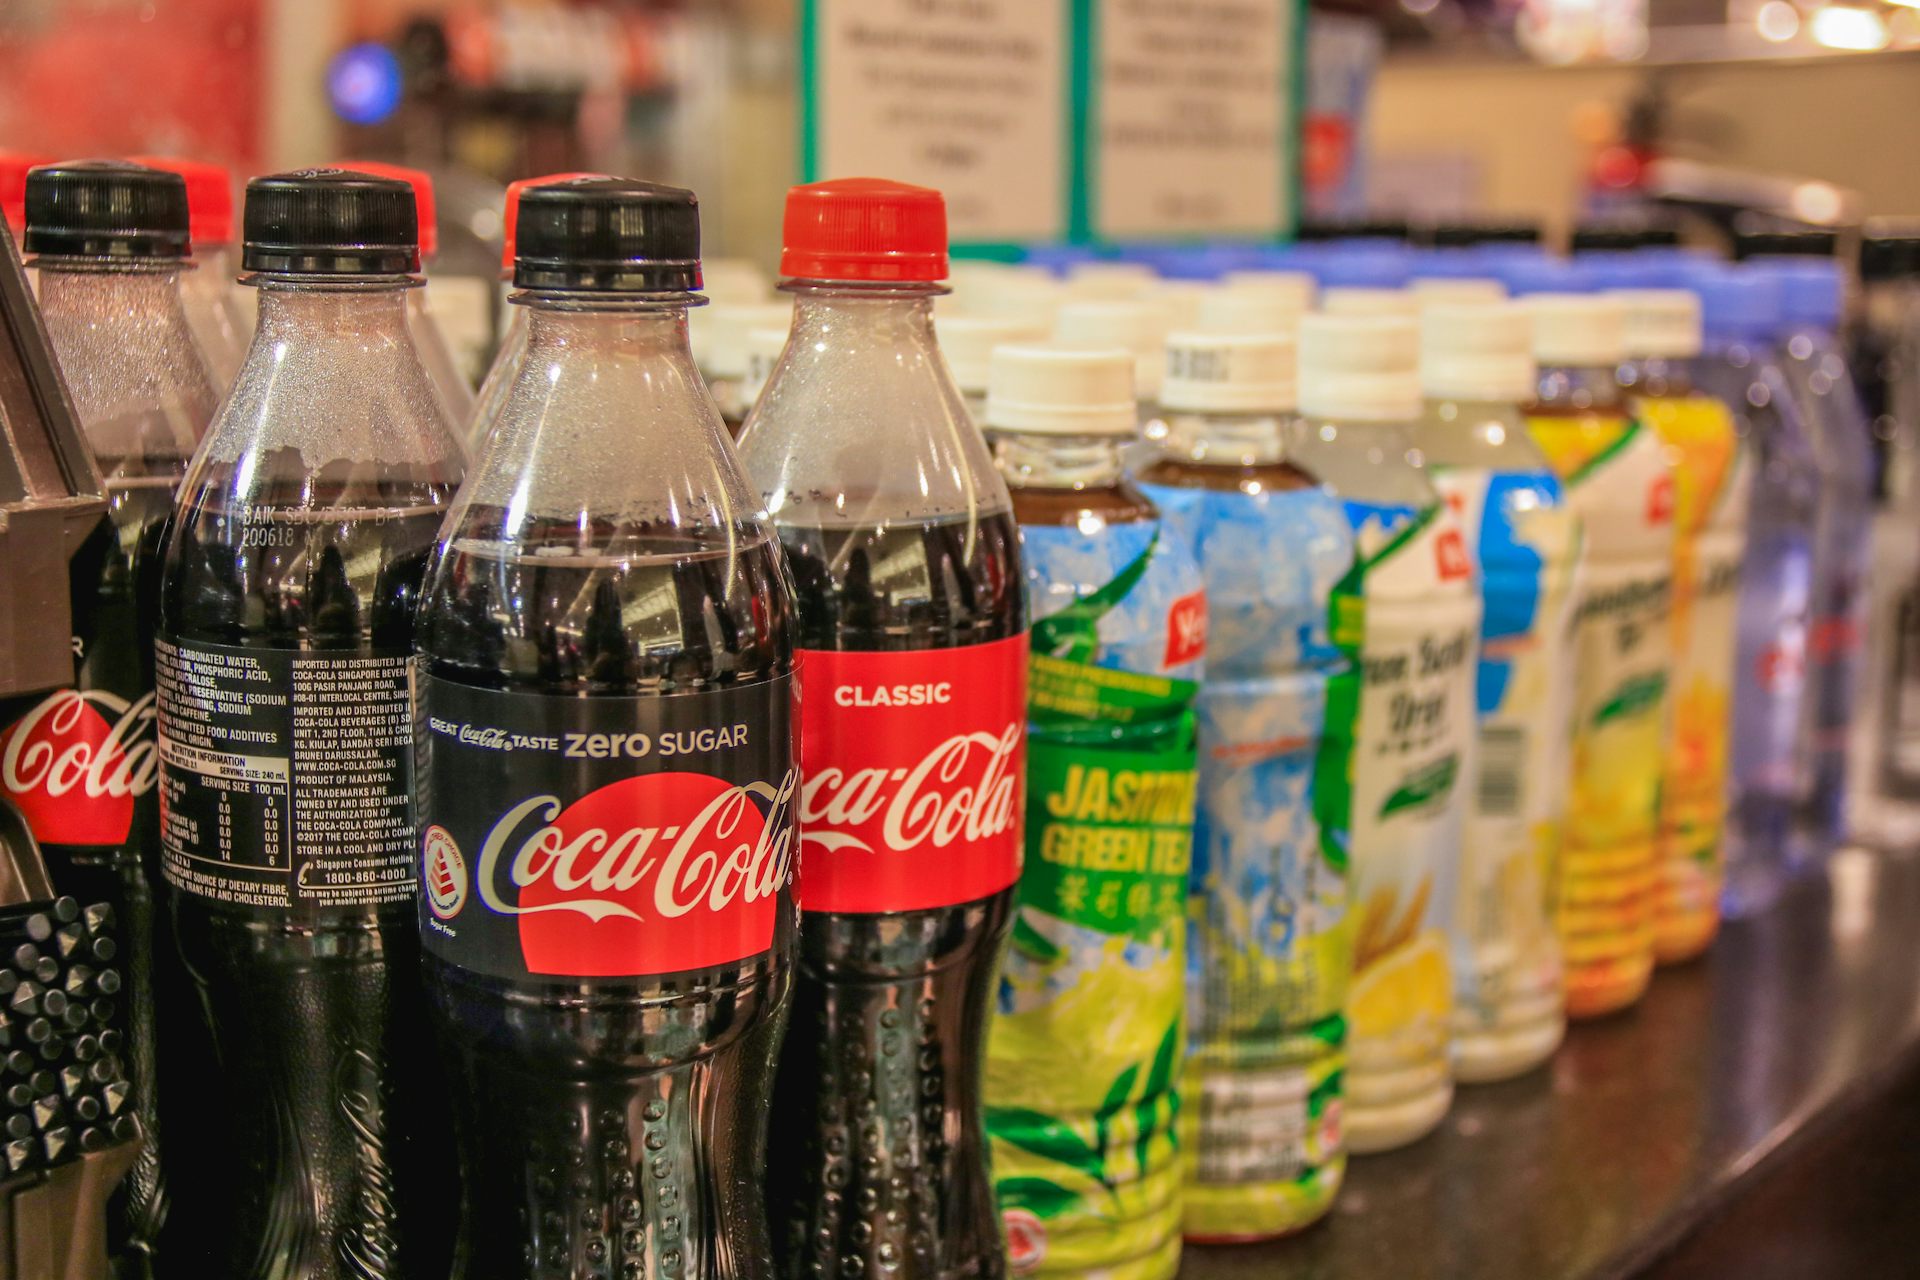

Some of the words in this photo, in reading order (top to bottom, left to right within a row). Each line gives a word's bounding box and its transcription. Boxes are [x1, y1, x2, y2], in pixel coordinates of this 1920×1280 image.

[243, 506, 276, 526] BAIK
[242, 527, 294, 547] 200618
[179, 648, 224, 666] CARBONATED
[226, 656, 261, 670] WATER,
[292, 660, 330, 669] IMPORTED
[331, 660, 347, 669] AND
[349, 658, 395, 668] DISTRIBUTED
[397, 657, 404, 666] IN
[176, 671, 218, 689] (SUCRALOSE,
[194, 663, 244, 679] PHOSPHORIC
[245, 670, 271, 683] ACID,
[293, 671, 336, 681] COCA-COLA
[338, 670, 380, 679] SINGAPORE
[314, 682, 336, 692] PASIR
[338, 681, 372, 691] PANJANG
[834, 682, 951, 706] CLASSIC
[189, 684, 243, 703] PRESERVATIVE
[245, 694, 287, 706] (SODIUM
[293, 693, 317, 703] #08-01
[319, 692, 362, 702] INTERLOCAL
[363, 691, 392, 701] CENTRE,
[175, 693, 217, 713] FLAVOURING,
[218, 702, 251, 716] SODIUM
[293, 706, 333, 716] IMPORTED
[336, 706, 352, 716] AND
[354, 704, 403, 715] DISTRIBUTED
[180, 707, 212, 722] CAFFEINE.
[294, 718, 339, 727] COCA-COLA
[341, 716, 386, 727] BEVERAGES
[388, 716, 399, 725] (B)
[172, 718, 205, 735] PERMITTED
[206, 727, 227, 739] FOOD
[229, 730, 278, 743] ADDITIVES
[294, 729, 312, 738] UNIT
[313, 729, 320, 739] 1,
[322, 729, 338, 738] 2ND
[340, 728, 367, 738] FLOOR,
[369, 727, 387, 736] TIAN
[388, 727, 394, 735] &
[430, 717, 458, 736] GREAT
[511, 735, 559, 751] TASTE
[565, 733, 651, 759] zero
[658, 723, 749, 756] SUGAR
[294, 740, 307, 749] KG.
[309, 740, 340, 750] KIULAP,
[341, 739, 373, 749] BANDAR
[375, 738, 393, 748] SERI
[394, 736, 414, 746] BEGA
[171, 743, 196, 758] NUTRITION
[198, 749, 245, 767] INFORMATION
[295, 751, 323, 760] BRUNEI
[325, 749, 381, 760] DARUSSALAM.
[295, 759, 397, 771] WWW.COCA-COLA.COM.SG
[220, 766, 244, 777] SERVING
[245, 769, 260, 778] SIZE:
[262, 771, 274, 780] 240
[276, 772, 286, 780] mL
[295, 775, 334, 785] PRODUCT
[336, 775, 347, 784] OF
[349, 772, 394, 784] MALAYSIA.
[201, 775, 231, 791] SERVING
[232, 781, 250, 793] SIZE
[255, 783, 271, 794] 100
[273, 785, 286, 795] mL
[295, 788, 311, 798] ALL
[313, 787, 369, 798] TRADEMARKS
[371, 786, 388, 796] ARE
[801, 722, 1023, 854] ca-Cola
[221, 791, 227, 801] 0
[267, 796, 273, 806] 0
[296, 799, 325, 809] OWNED
[327, 799, 339, 809] BY
[340, 799, 358, 808] AND
[359, 798, 380, 808] USED
[382, 795, 409, 806] UNDER
[219, 803, 231, 814] 0.0
[264, 808, 278, 819] 0.0
[296, 810, 312, 820] THE
[313, 809, 379, 820] AUTHORIZATION
[380, 808, 391, 817] OF
[219, 815, 231, 826] 0.0
[264, 820, 278, 831] 0.0
[296, 821, 312, 830] THE
[314, 820, 361, 831] COCA-COLA
[363, 817, 404, 829] COMPANY.
[219, 827, 231, 838] 0.0
[264, 832, 278, 842] 0.0
[325, 832, 341, 841] THE
[343, 830, 390, 841] COCA-COLA
[219, 838, 231, 850] 0.0
[265, 844, 279, 855] 0.0
[296, 845, 323, 855] STORE
[325, 845, 334, 855] IN
[335, 845, 342, 855] A
[344, 844, 365, 854] COOL
[367, 843, 384, 853] AND
[385, 842, 401, 852] DRY
[477, 765, 801, 923] Coca-Cola
[1041, 823, 1150, 873] GREEN
[1152, 829, 1194, 876] TE
[221, 851, 231, 861] 14
[269, 856, 275, 866] 6
[316, 859, 352, 871] Singapore
[353, 857, 388, 868] Consumer
[389, 855, 414, 865] Hotline
[325, 868, 406, 884] 1800-860-4000
[193, 872, 216, 887] SOURCE
[218, 878, 227, 889] OF
[229, 879, 260, 893] DIETARY
[262, 883, 289, 897] FIBRE,
[186, 881, 204, 896] TRANS
[204, 887, 215, 899] FAT
[217, 889, 233, 902] AND
[234, 891, 292, 908] CHOLESTEROL.
[298, 889, 316, 898] Calls
[316, 890, 330, 899] may
[341, 888, 366, 899] subject
[335, 896, 357, 906] mobile
[358, 895, 382, 905] service
